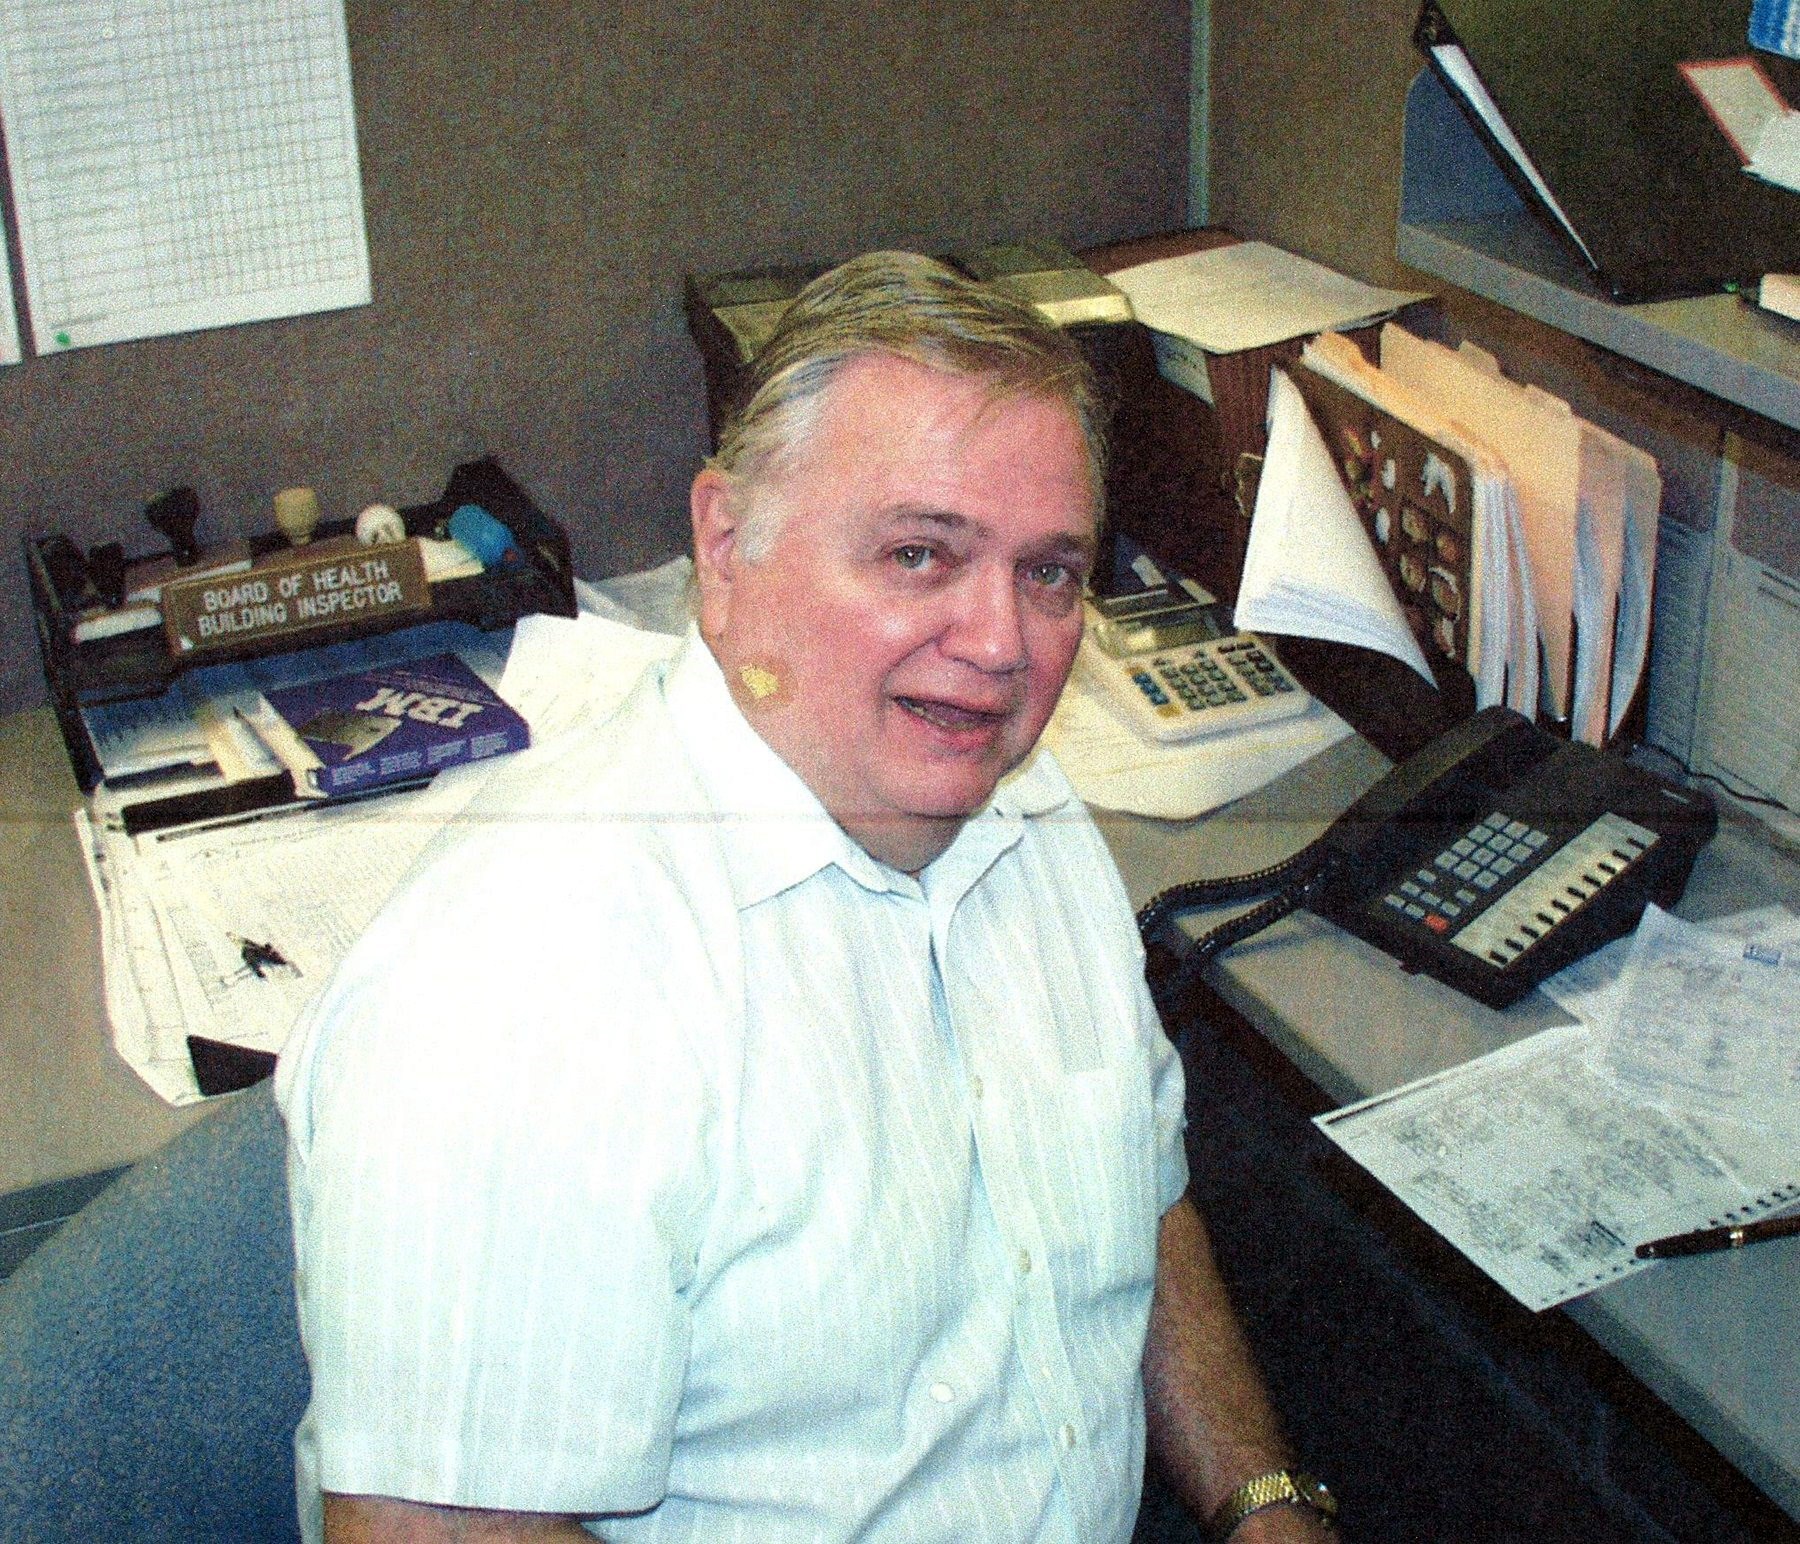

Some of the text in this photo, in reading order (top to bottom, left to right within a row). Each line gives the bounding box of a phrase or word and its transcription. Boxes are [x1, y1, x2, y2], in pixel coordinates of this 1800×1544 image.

[198, 581, 403, 637] BUILDING INSPECTOR
[203, 560, 390, 613] BOARD OF HEALTH
[355, 687, 484, 729] IBM
